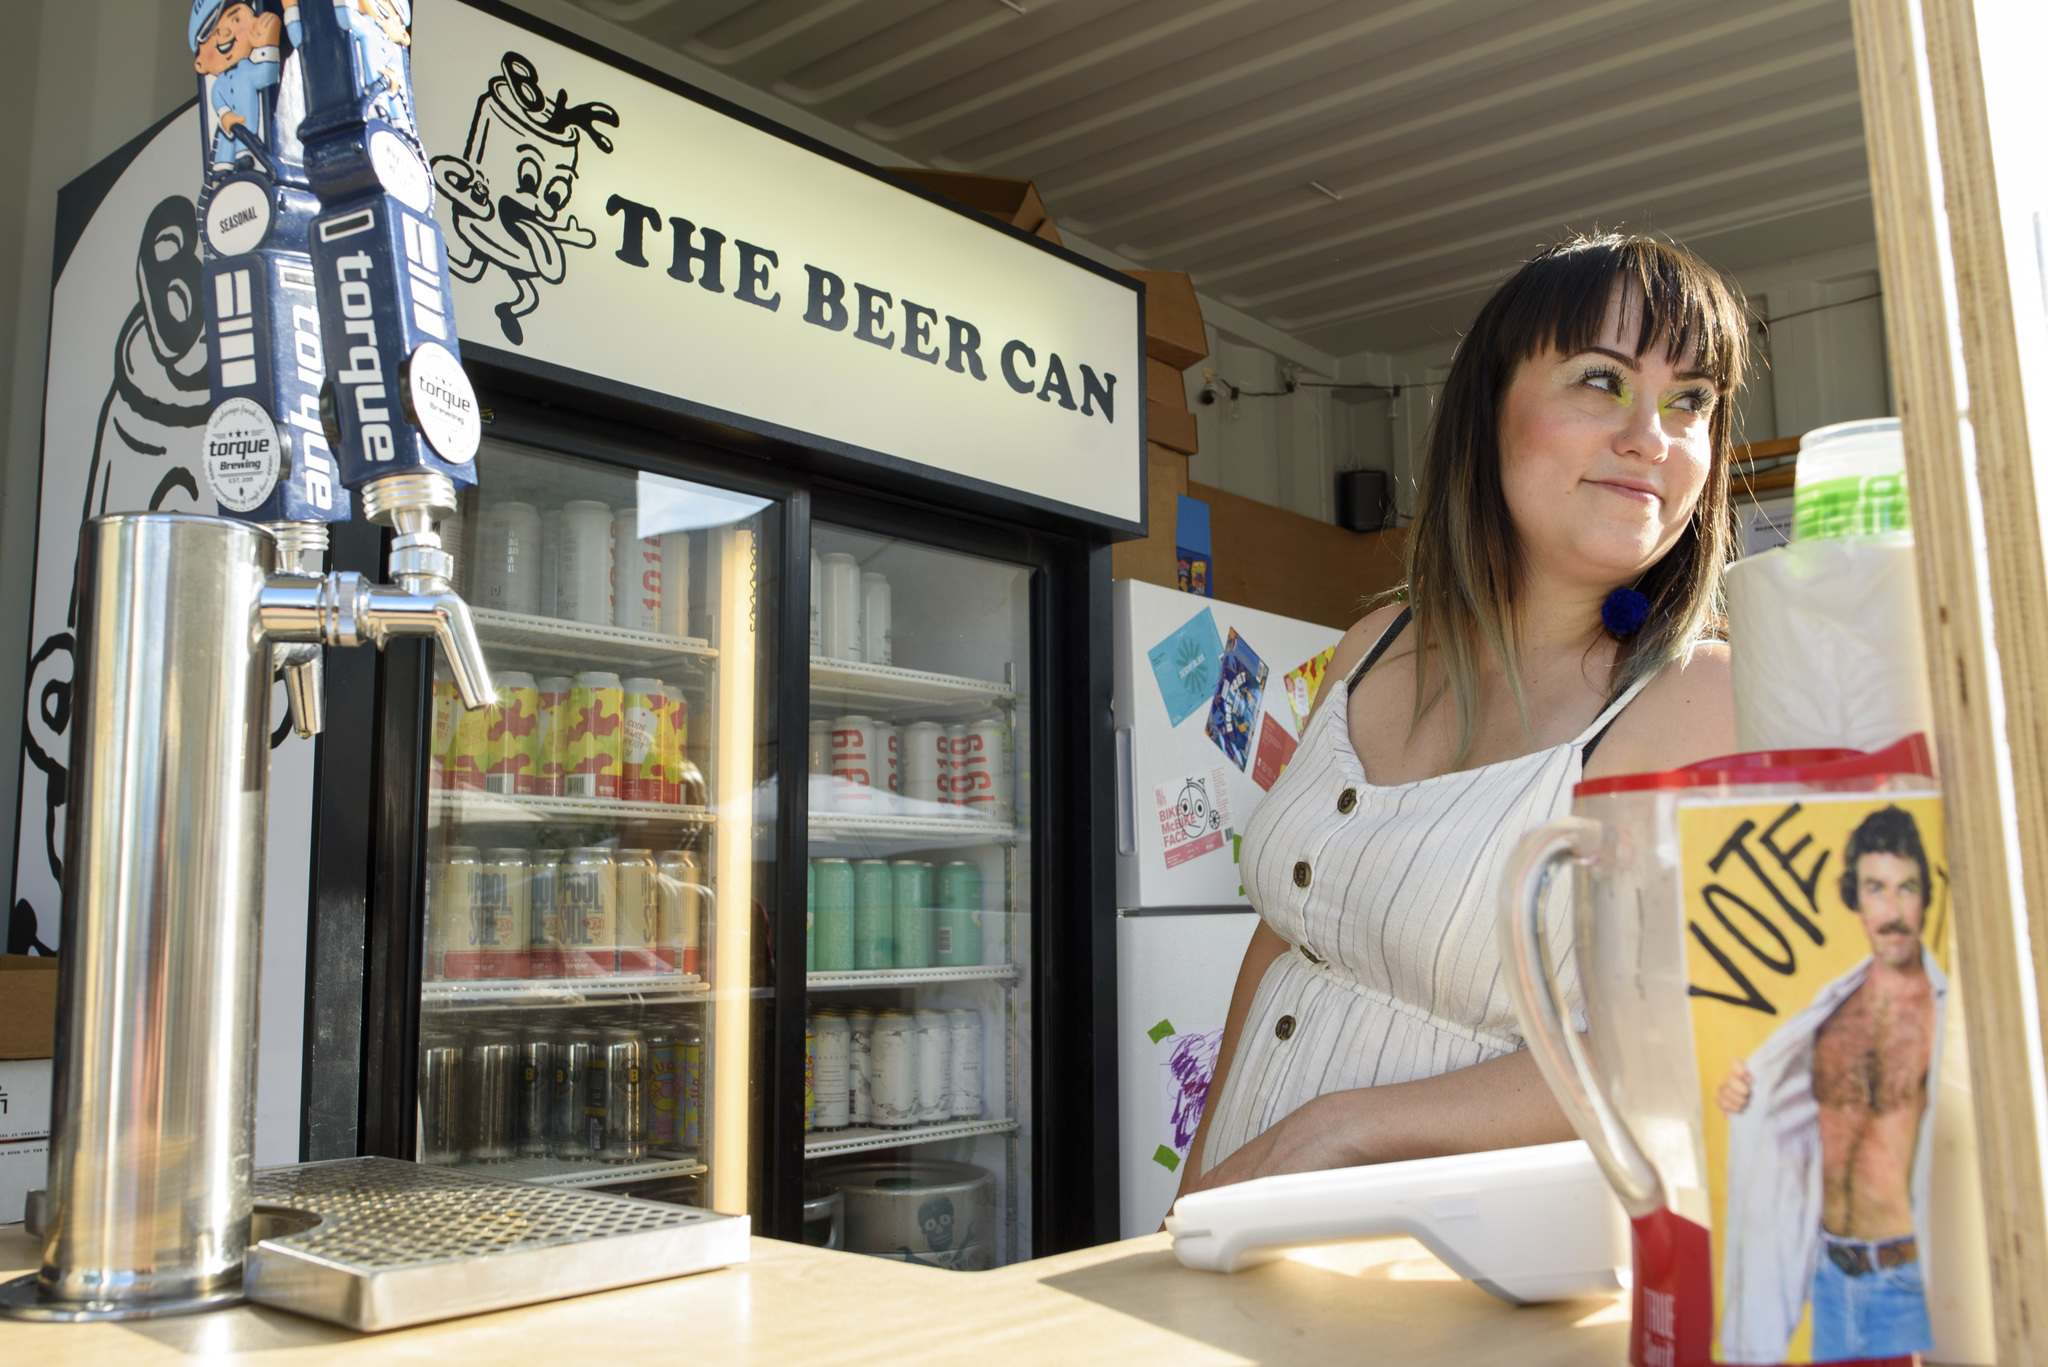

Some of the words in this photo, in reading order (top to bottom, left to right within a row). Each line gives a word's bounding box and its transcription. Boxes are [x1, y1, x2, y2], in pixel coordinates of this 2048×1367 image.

[219, 206, 257, 234] SEASONAL
[606, 194, 781, 312] THE
[803, 263, 987, 381] BEER
[1000, 339, 1117, 424] CAN
[336, 250, 395, 462] torque
[419, 375, 471, 412] torque
[209, 438, 270, 460] torque
[219, 460, 262, 471] Brewing
[1159, 803, 1184, 822] BIKE
[1163, 830, 1188, 847] FACE
[1687, 802, 1830, 1015] VOTE
